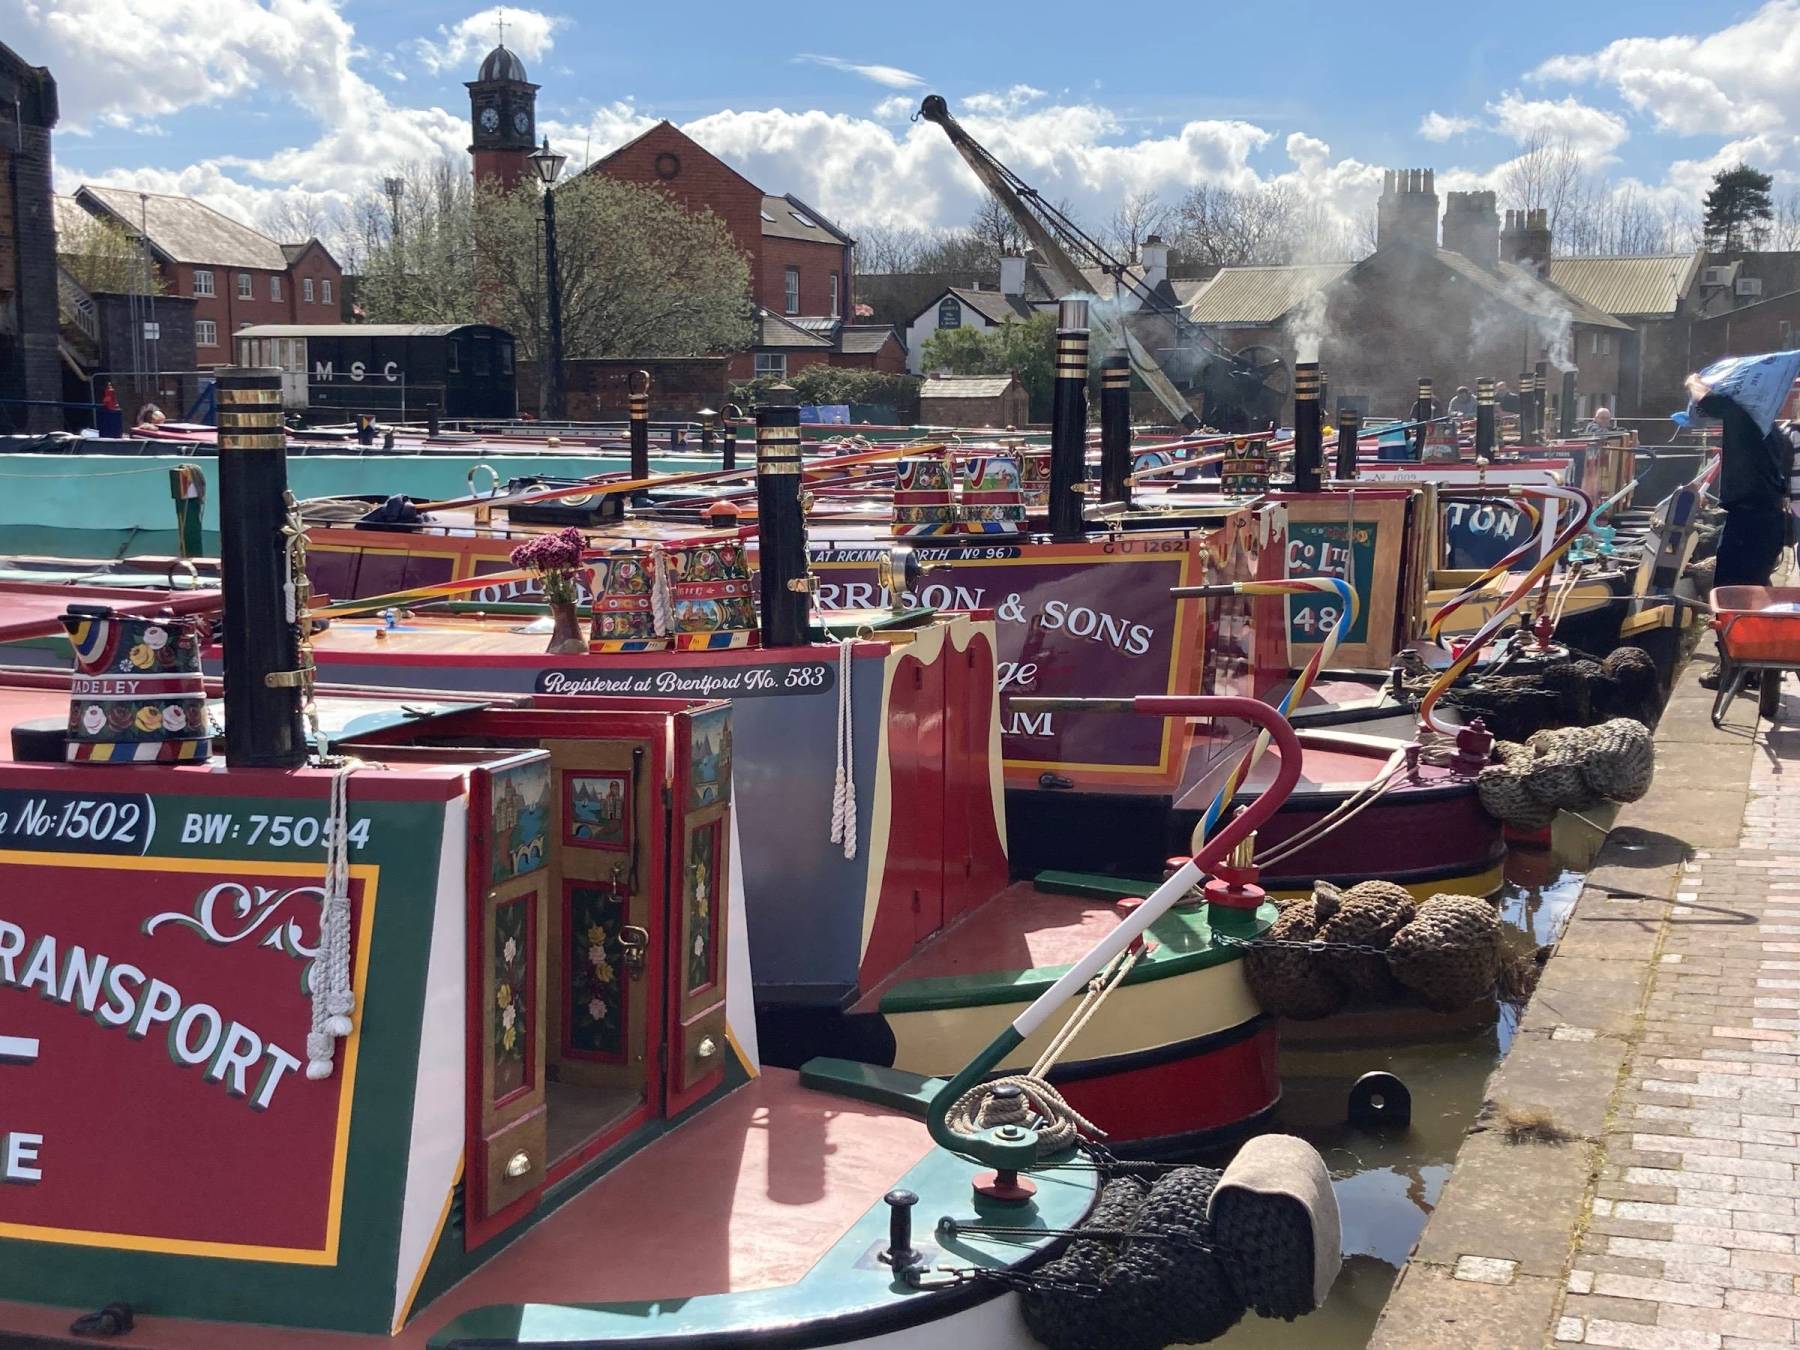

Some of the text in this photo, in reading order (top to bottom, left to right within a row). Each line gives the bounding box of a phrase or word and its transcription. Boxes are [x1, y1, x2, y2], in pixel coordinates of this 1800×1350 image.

[1446, 502, 1521, 537] TON
[815, 550, 834, 562] AT
[998, 593, 1026, 623] &
[1040, 600, 1154, 655] SONS
[1293, 606, 1338, 632] 48
[544, 666, 825, 696] Registered at Brentford No. 583
